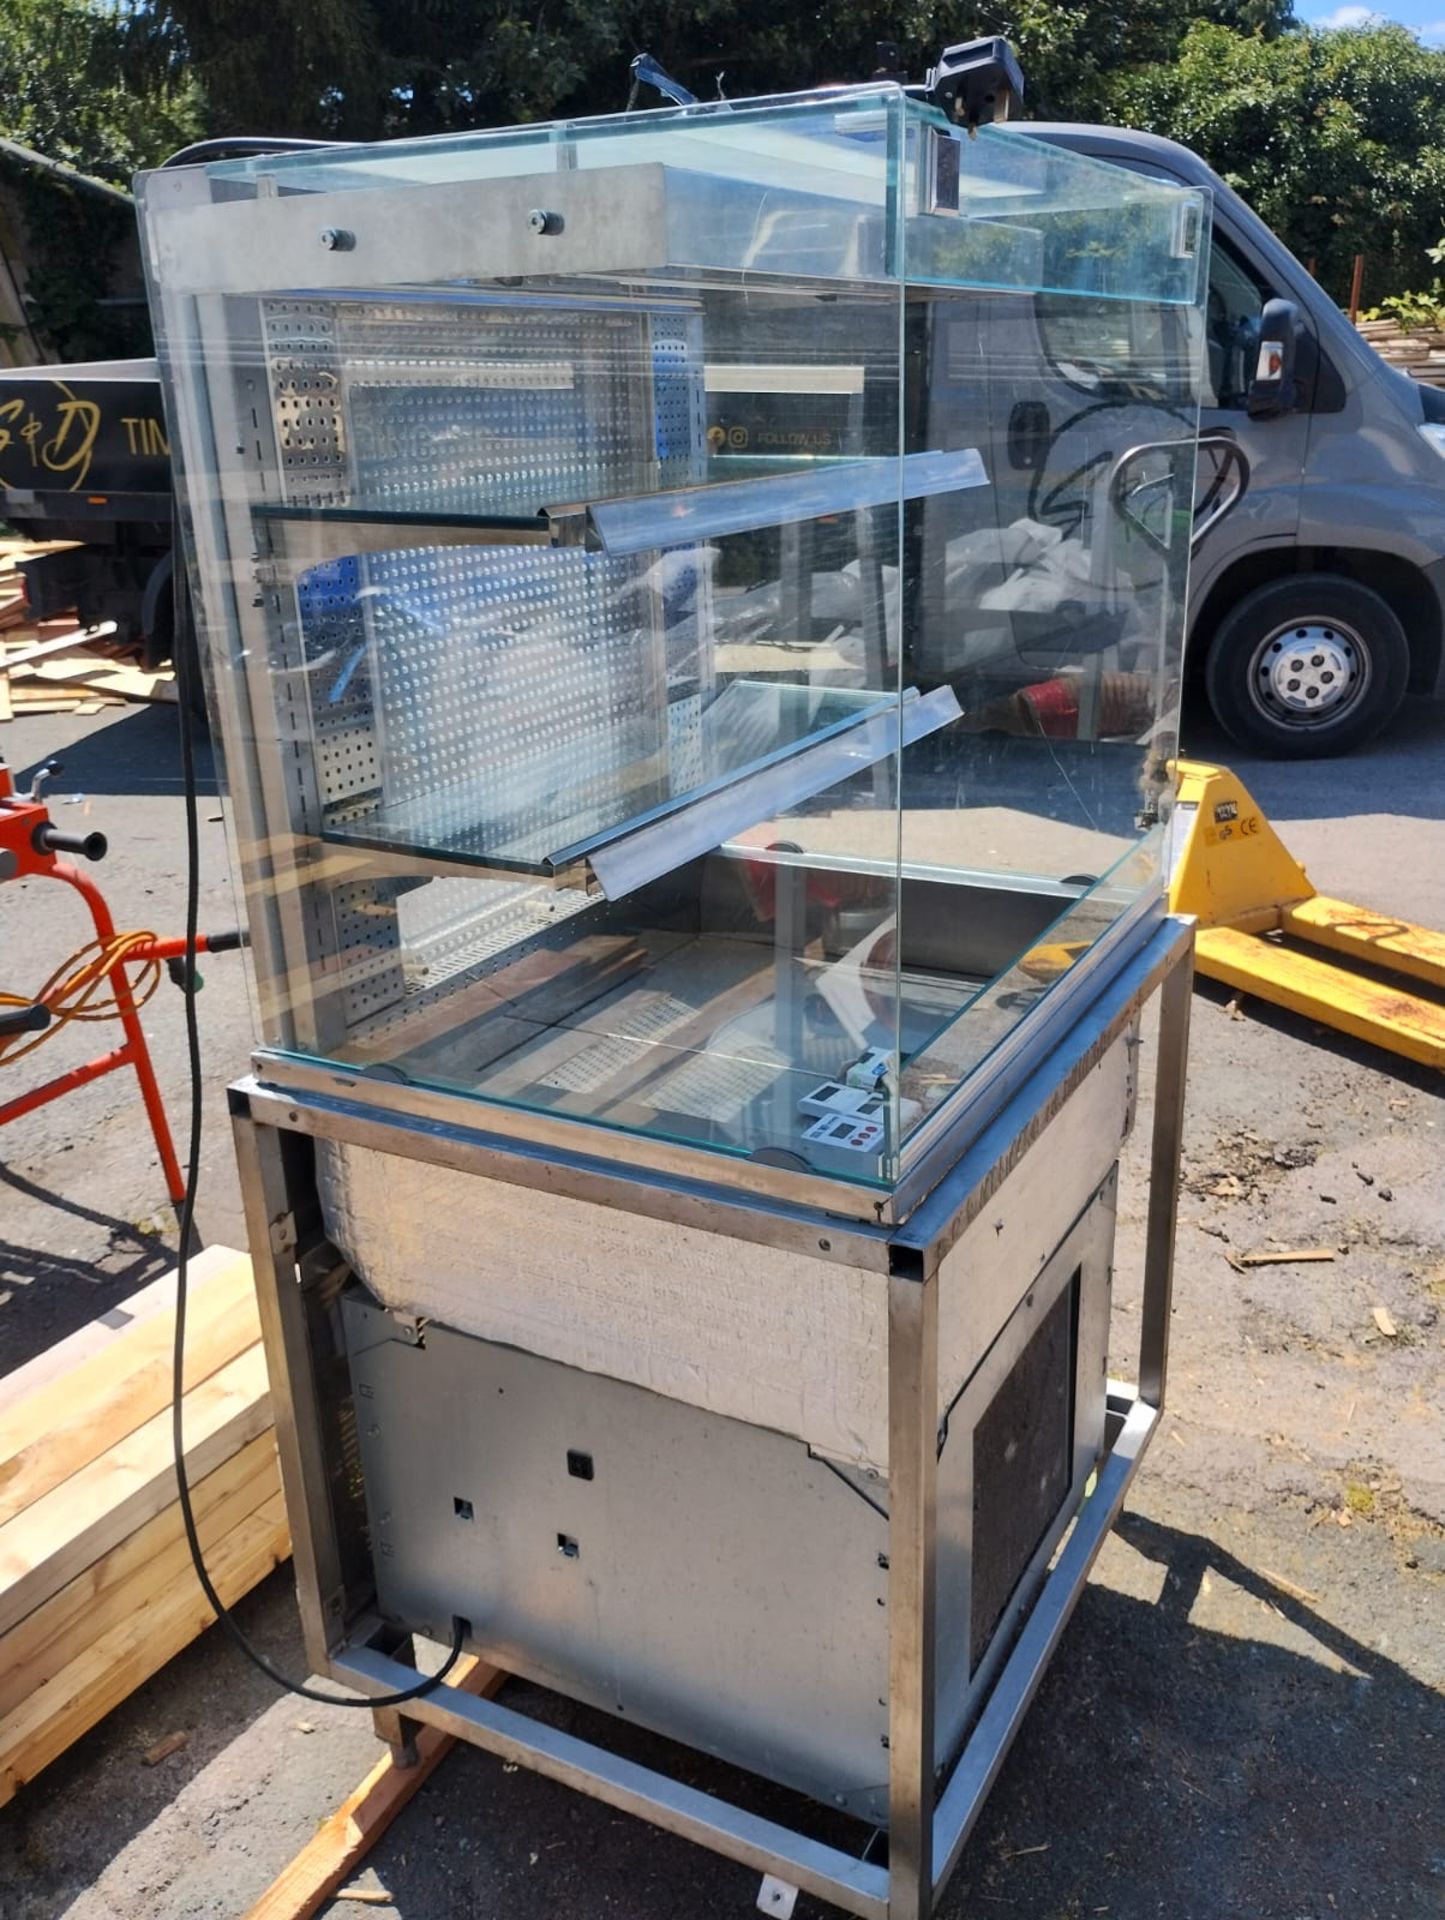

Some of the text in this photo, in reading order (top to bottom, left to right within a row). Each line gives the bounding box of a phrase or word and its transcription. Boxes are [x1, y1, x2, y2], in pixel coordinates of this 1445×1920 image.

[20, 412, 42, 468] &
[42, 401, 101, 471] D
[758, 432, 831, 447] FOLLOW US
[1240, 816, 1257, 836] CE
